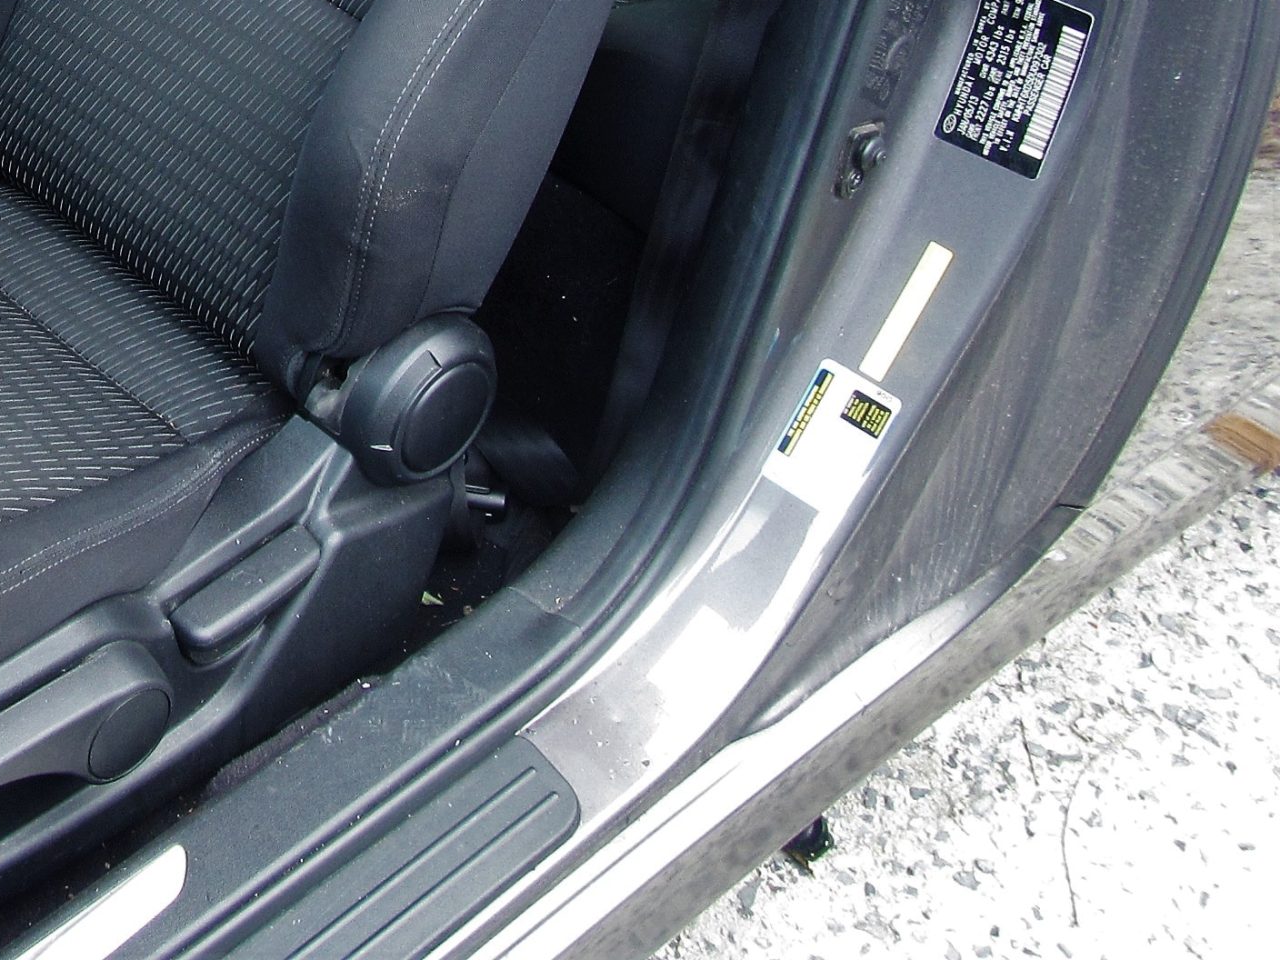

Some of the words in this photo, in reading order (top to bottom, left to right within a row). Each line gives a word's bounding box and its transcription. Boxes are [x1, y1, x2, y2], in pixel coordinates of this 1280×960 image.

[983, 39, 999, 63] 4343
[995, 43, 1011, 66] 2315
[1039, 52, 1052, 71] CAR
[951, 74, 975, 116] HYUNDAI
[972, 33, 990, 65] MOTOR
[973, 99, 990, 123] 2227
